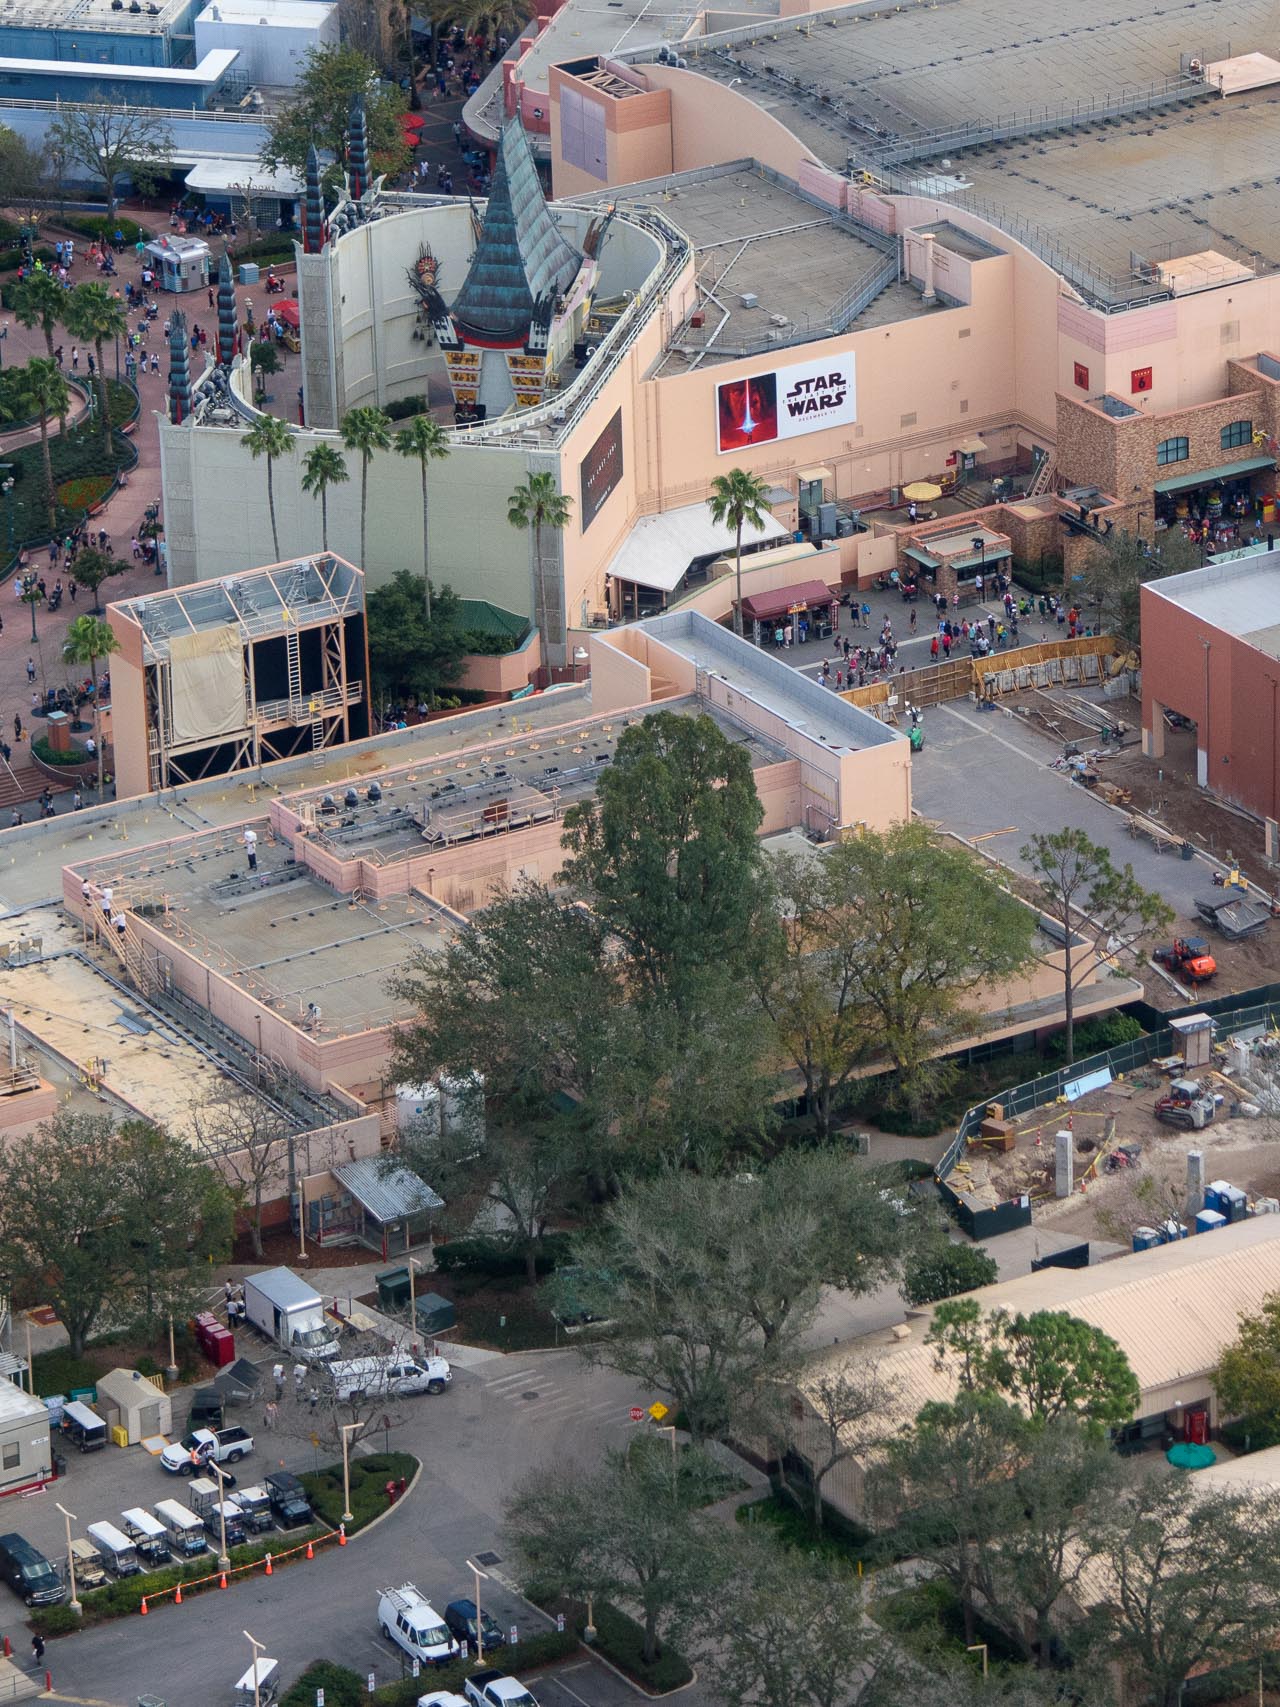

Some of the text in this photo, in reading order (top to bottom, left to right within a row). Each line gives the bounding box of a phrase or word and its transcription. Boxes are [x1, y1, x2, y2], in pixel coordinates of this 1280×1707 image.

[786, 372, 847, 398] STAR
[1138, 377, 1146, 389] 6
[787, 390, 847, 417] WARS
